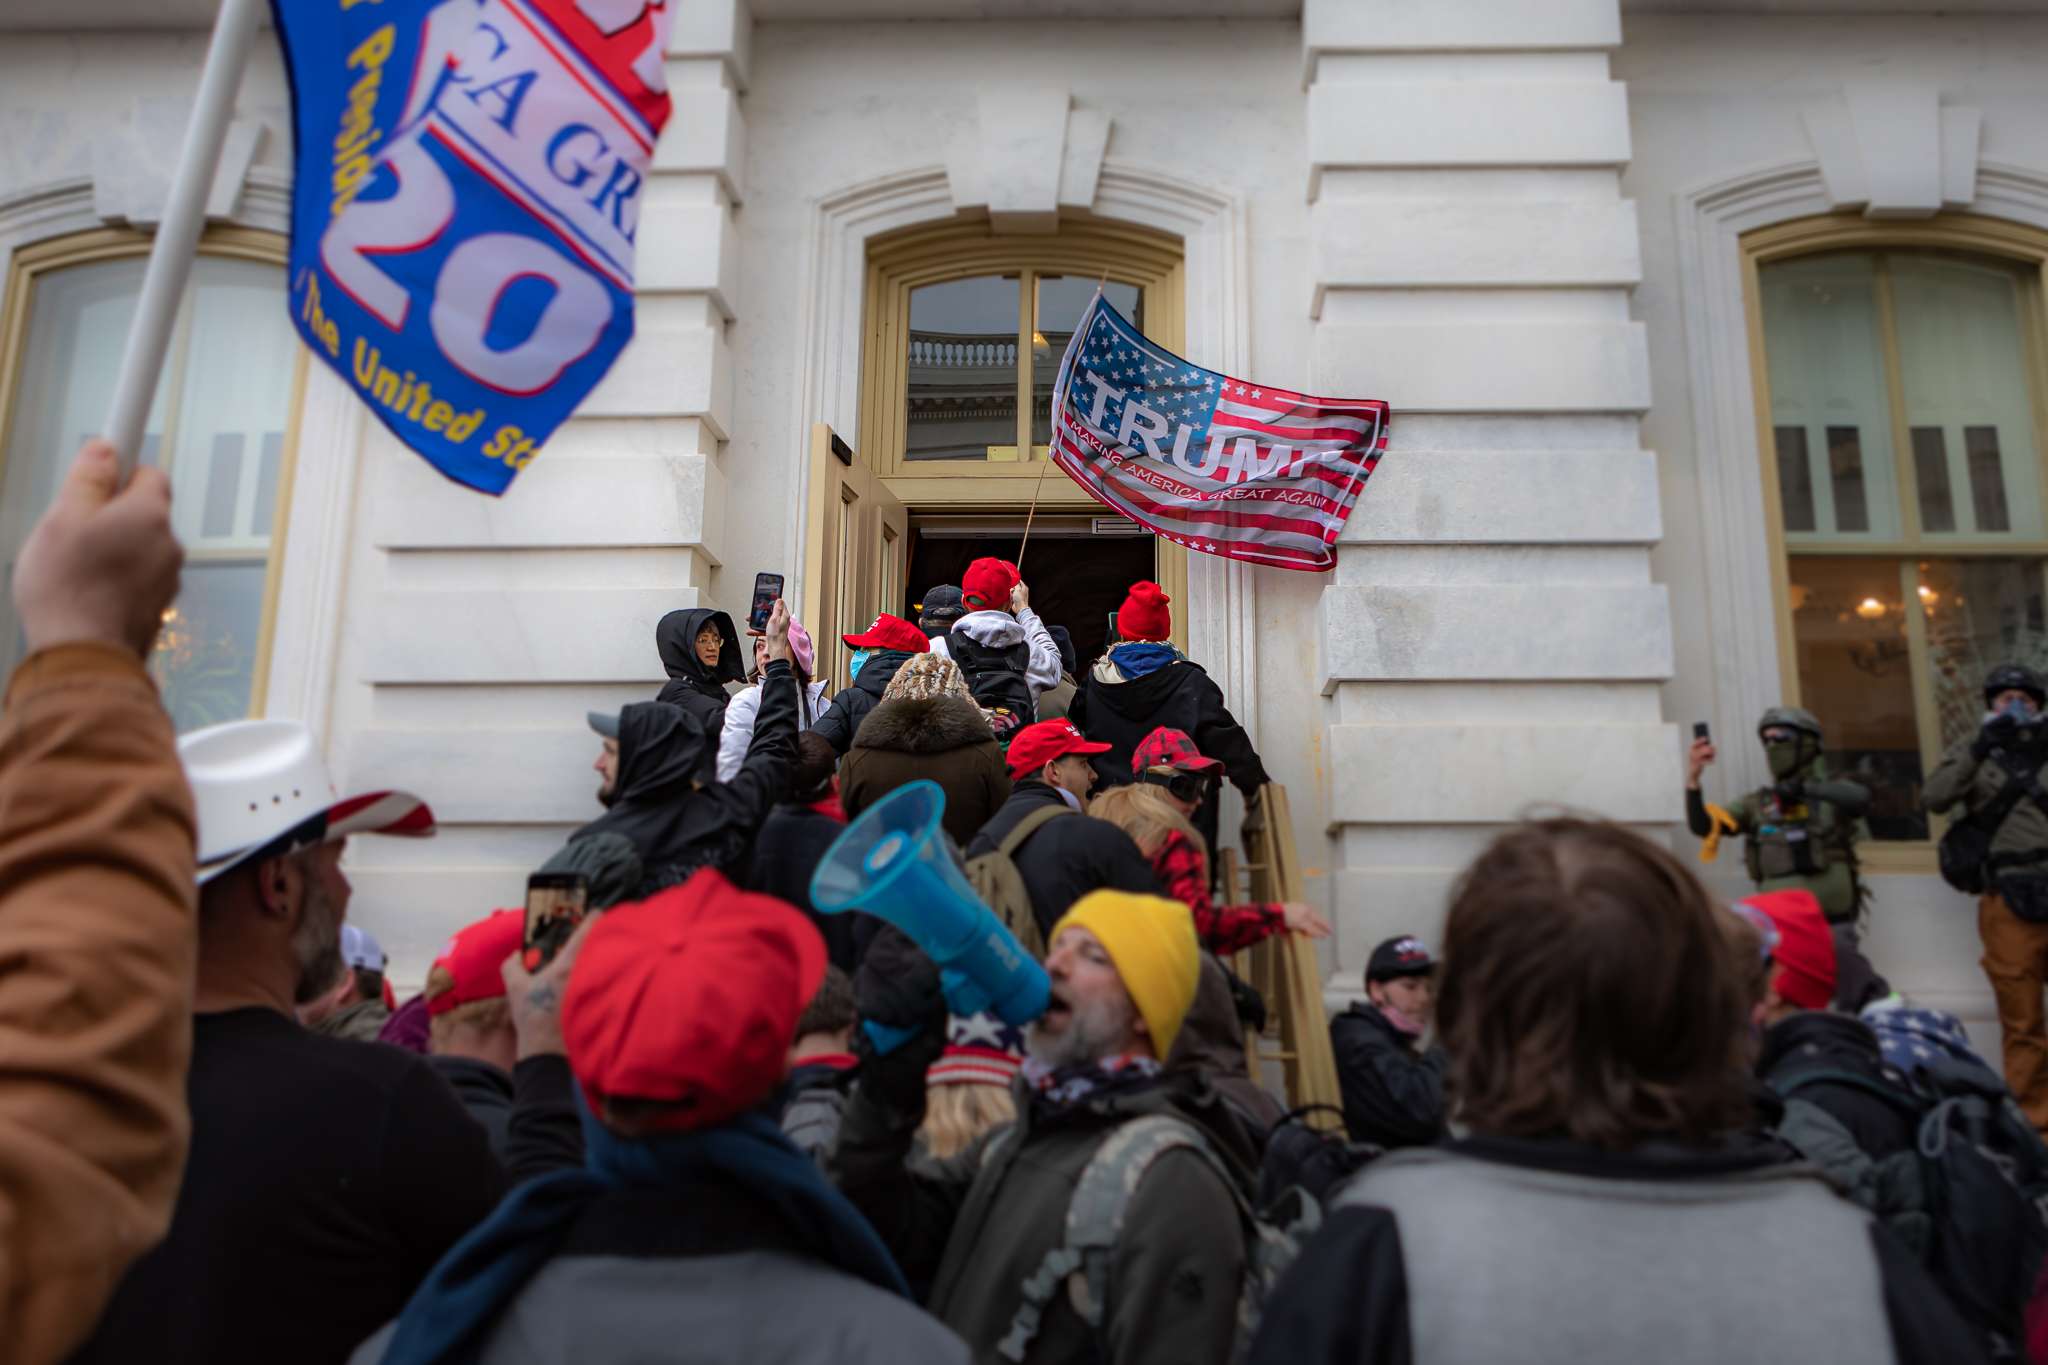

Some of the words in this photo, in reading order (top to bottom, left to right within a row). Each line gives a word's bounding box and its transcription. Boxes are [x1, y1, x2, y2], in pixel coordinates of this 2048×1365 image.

[353, 337, 486, 443] United
[1070, 420, 1123, 467] MAKING
[1126, 463, 1202, 501] AMERICA
[1207, 488, 1272, 501] GREAT
